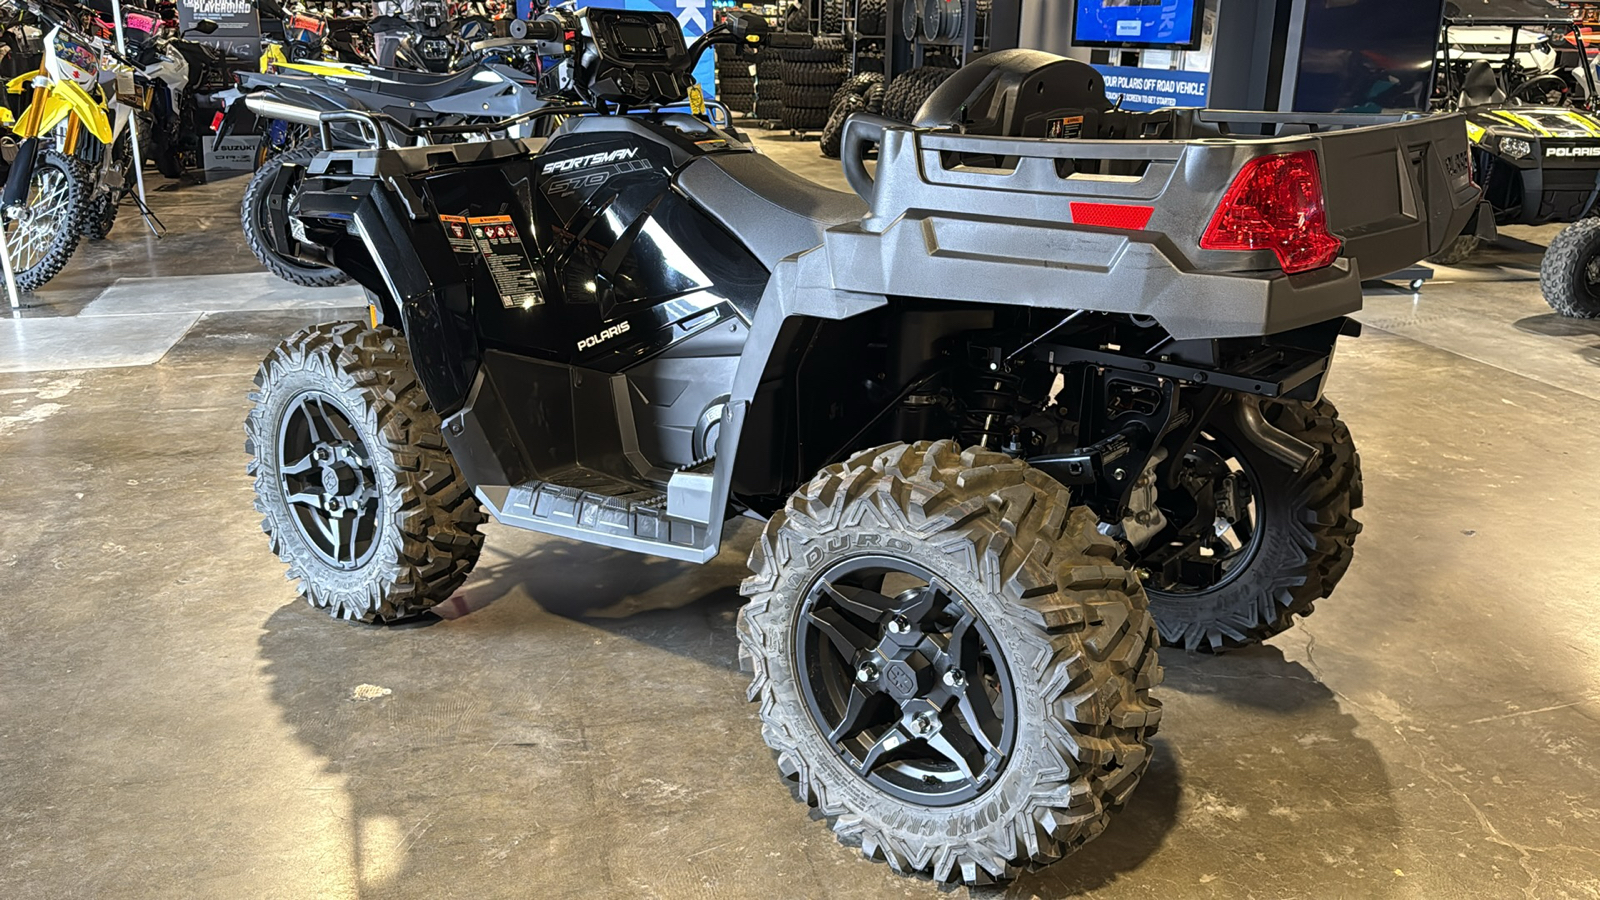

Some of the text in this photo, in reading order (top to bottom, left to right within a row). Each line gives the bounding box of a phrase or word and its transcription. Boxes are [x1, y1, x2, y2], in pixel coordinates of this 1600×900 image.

[193, 3, 251, 14] PLAYGROUND
[1117, 77, 1143, 90] POLARIS
[1143, 79, 1157, 91] OFF
[1157, 80, 1175, 92] ROAD
[1175, 81, 1206, 96] VEHICLE
[1126, 93, 1142, 103] SCREEN
[1156, 98, 1176, 106] STARTED
[541, 147, 639, 175] SPORTSMAN
[1546, 147, 1600, 157] POLARIS
[547, 171, 609, 195] 570
[577, 320, 631, 352] POLARIS
[803, 533, 913, 570] DURO
[881, 810, 937, 837] GRIP
